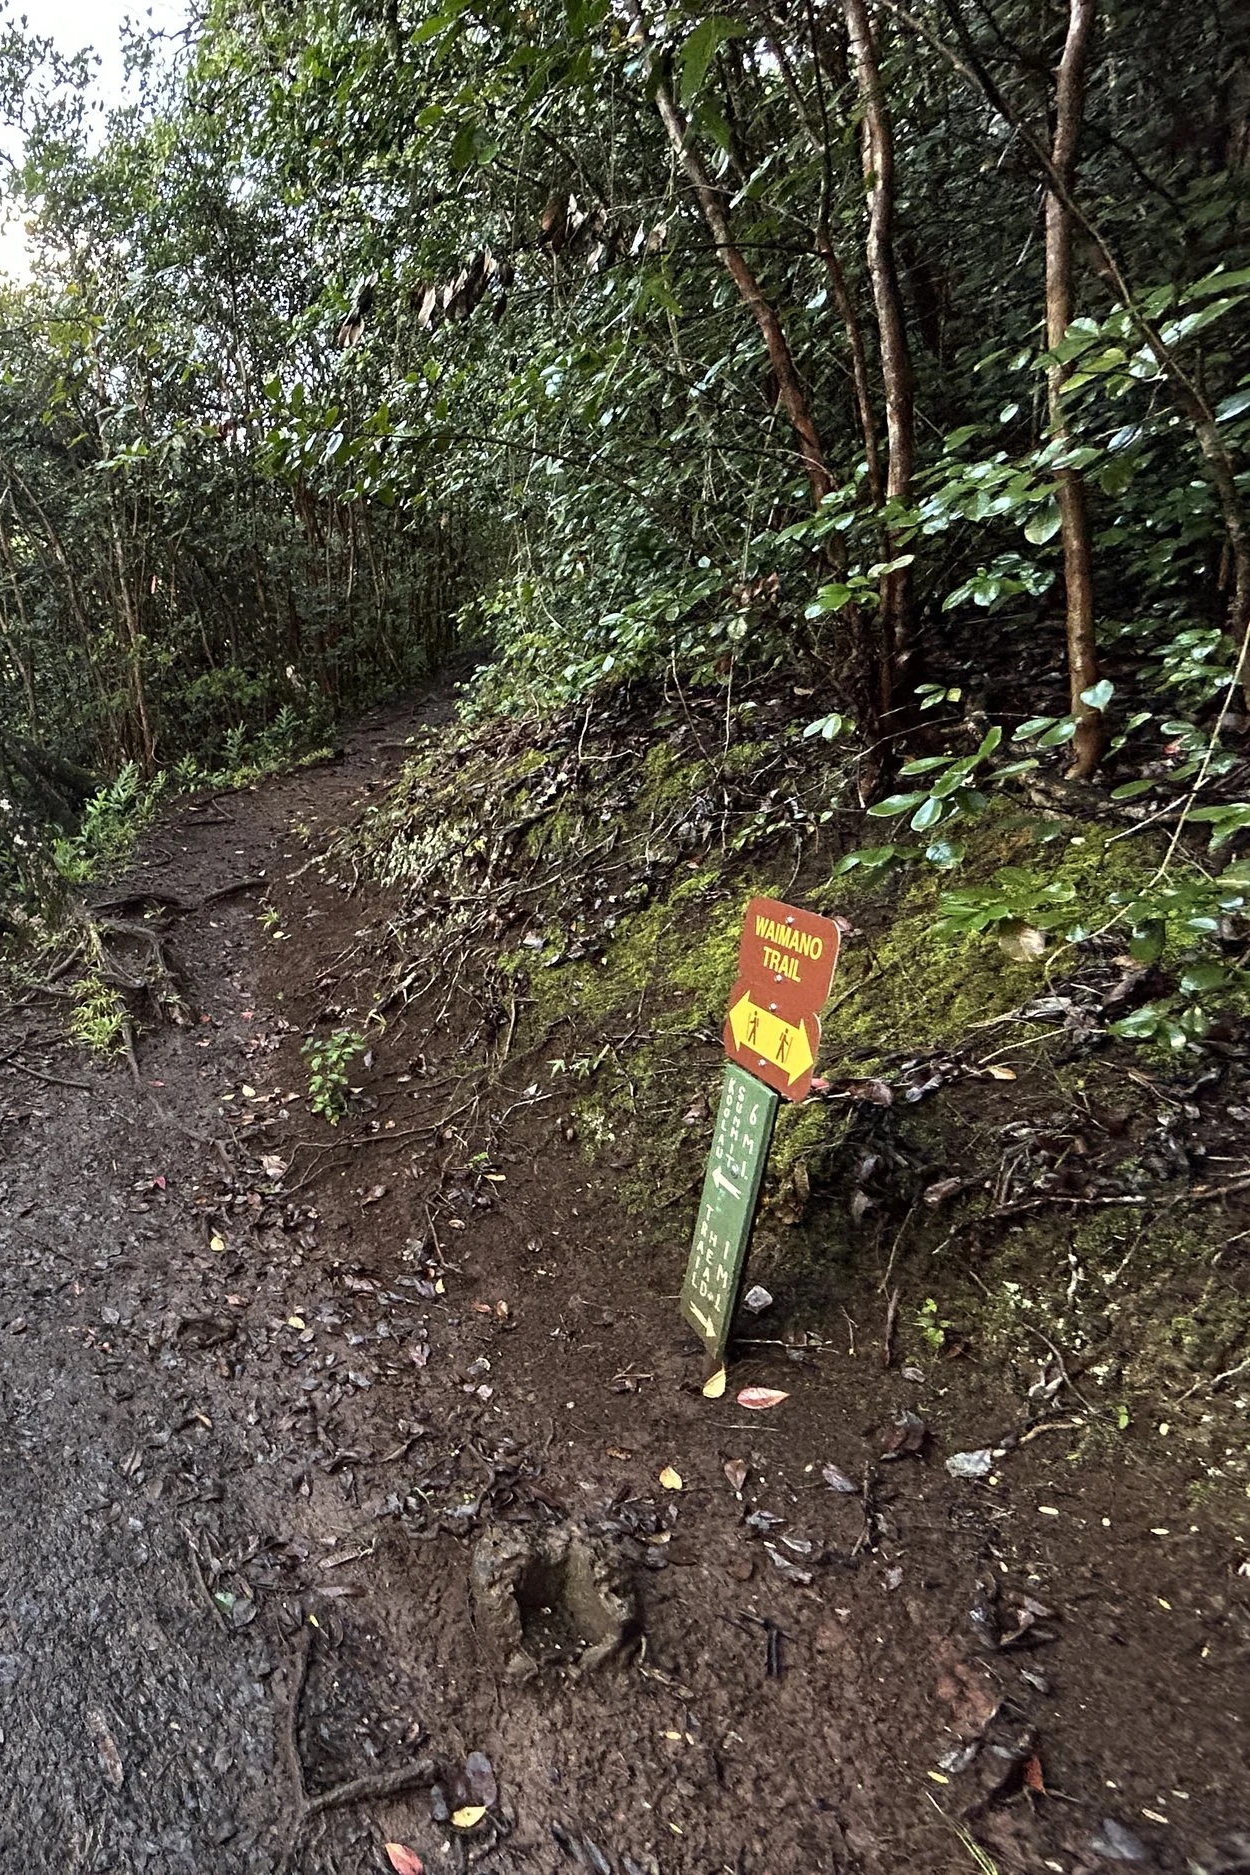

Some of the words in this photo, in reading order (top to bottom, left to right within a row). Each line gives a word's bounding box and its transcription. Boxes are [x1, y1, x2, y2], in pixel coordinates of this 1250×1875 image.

[755, 915, 823, 960] WAIMANO
[763, 946, 801, 983] TRAIL
[716, 1077, 736, 1159] KOOLAU
[726, 1085, 746, 1168] SUMMIT
[749, 1104, 759, 1126] 6
[691, 1203, 714, 1289] TRAIL
[700, 1230, 718, 1299] HEAD
